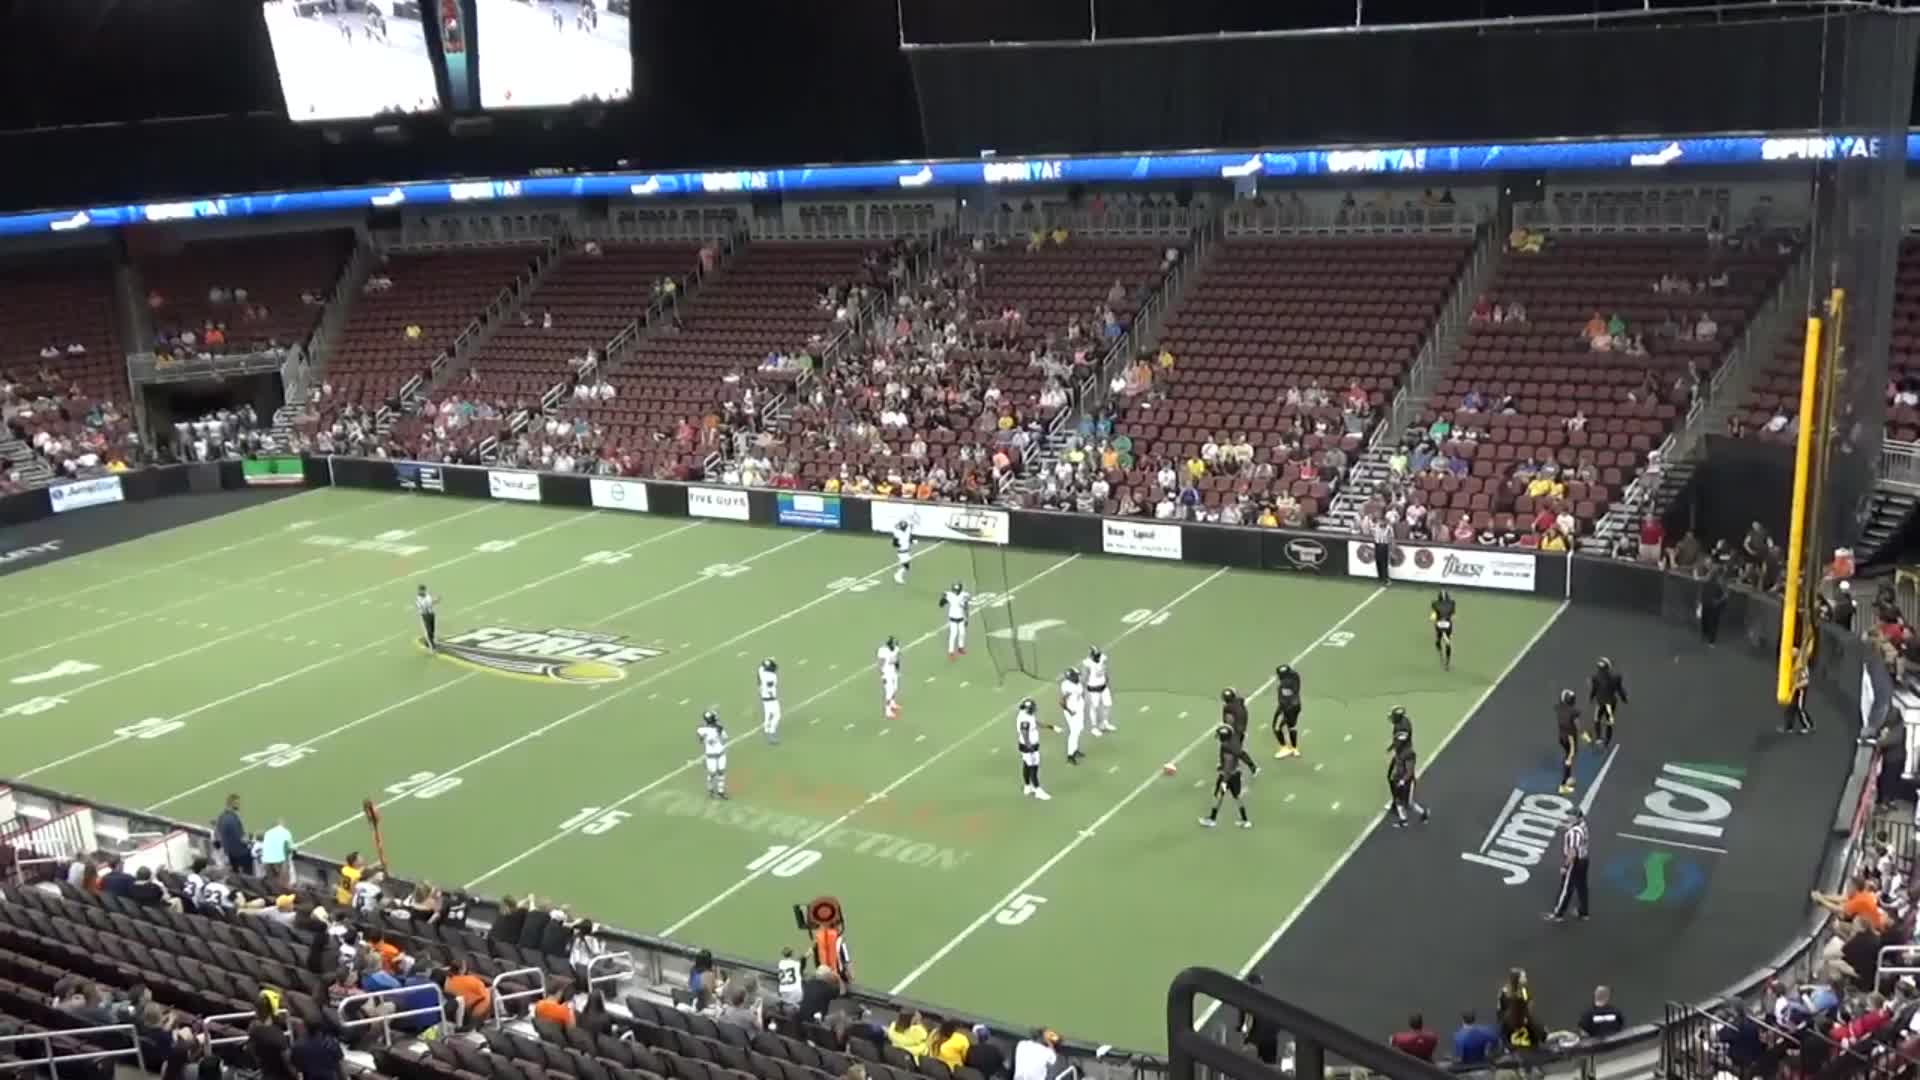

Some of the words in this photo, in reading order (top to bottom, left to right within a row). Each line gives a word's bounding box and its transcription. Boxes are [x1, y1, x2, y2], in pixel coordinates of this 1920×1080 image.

[446, 626, 669, 666] FORCE
[240, 743, 318, 768] 25
[385, 771, 463, 799] 20
[559, 806, 632, 835] 15
[745, 845, 822, 877] 10
[995, 893, 1048, 926] 5
[778, 968, 797, 986] 23
